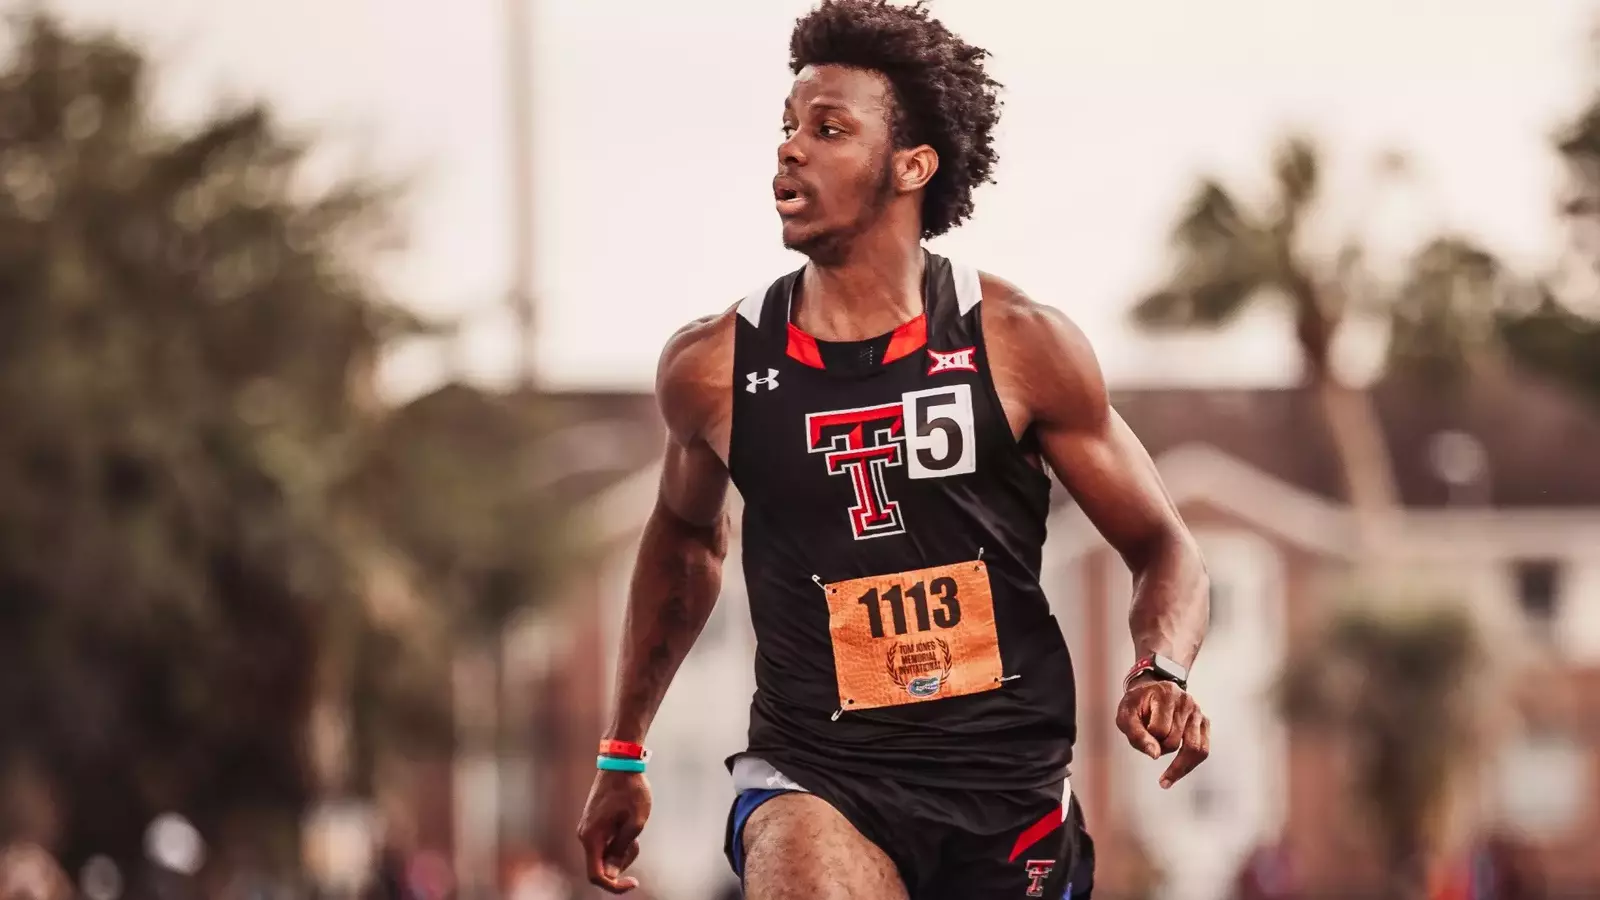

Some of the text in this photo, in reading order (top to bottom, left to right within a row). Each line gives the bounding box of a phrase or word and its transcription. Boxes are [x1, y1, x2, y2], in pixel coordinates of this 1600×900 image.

[915, 392, 963, 470] 5
[858, 577, 961, 638] 1113
[899, 641, 936, 654] TOM JONES
[901, 651, 936, 665] MEMORIAL
